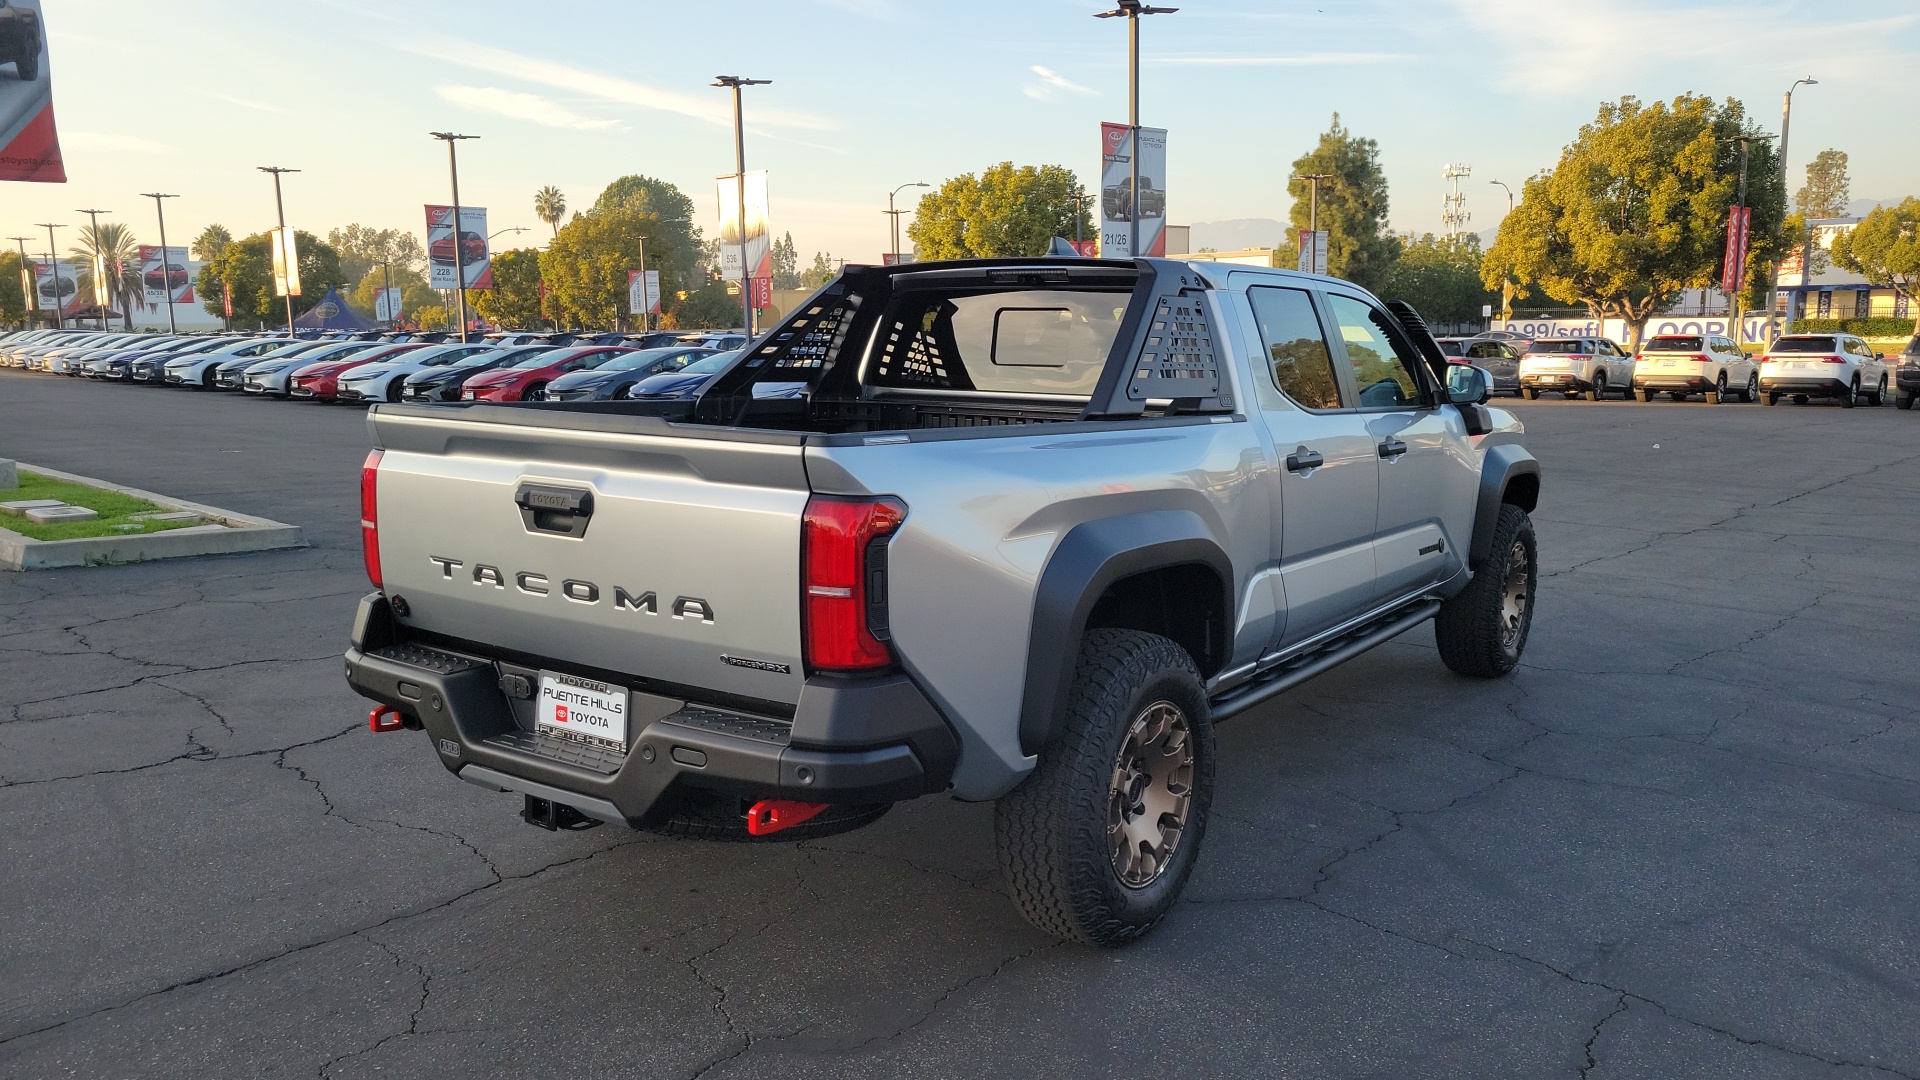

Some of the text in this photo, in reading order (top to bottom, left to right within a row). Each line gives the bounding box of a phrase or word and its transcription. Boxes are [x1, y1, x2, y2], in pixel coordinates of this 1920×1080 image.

[1104, 233, 1127, 245] 21/26
[1726, 213, 1738, 287] TOYOTA
[1737, 213, 1748, 287] TOYOTA
[436, 268, 451, 276] 228
[1506, 321, 1782, 343] 099/sqft FLOORNG
[532, 494, 567, 507] TOYOTA
[430, 555, 715, 625] TACOMA
[560, 674, 607, 691] TOYOTA
[543, 687, 622, 714] PUENTE HILLS
[570, 710, 609, 728] TOYOTA
[540, 724, 620, 750] PUENTE HILLS
